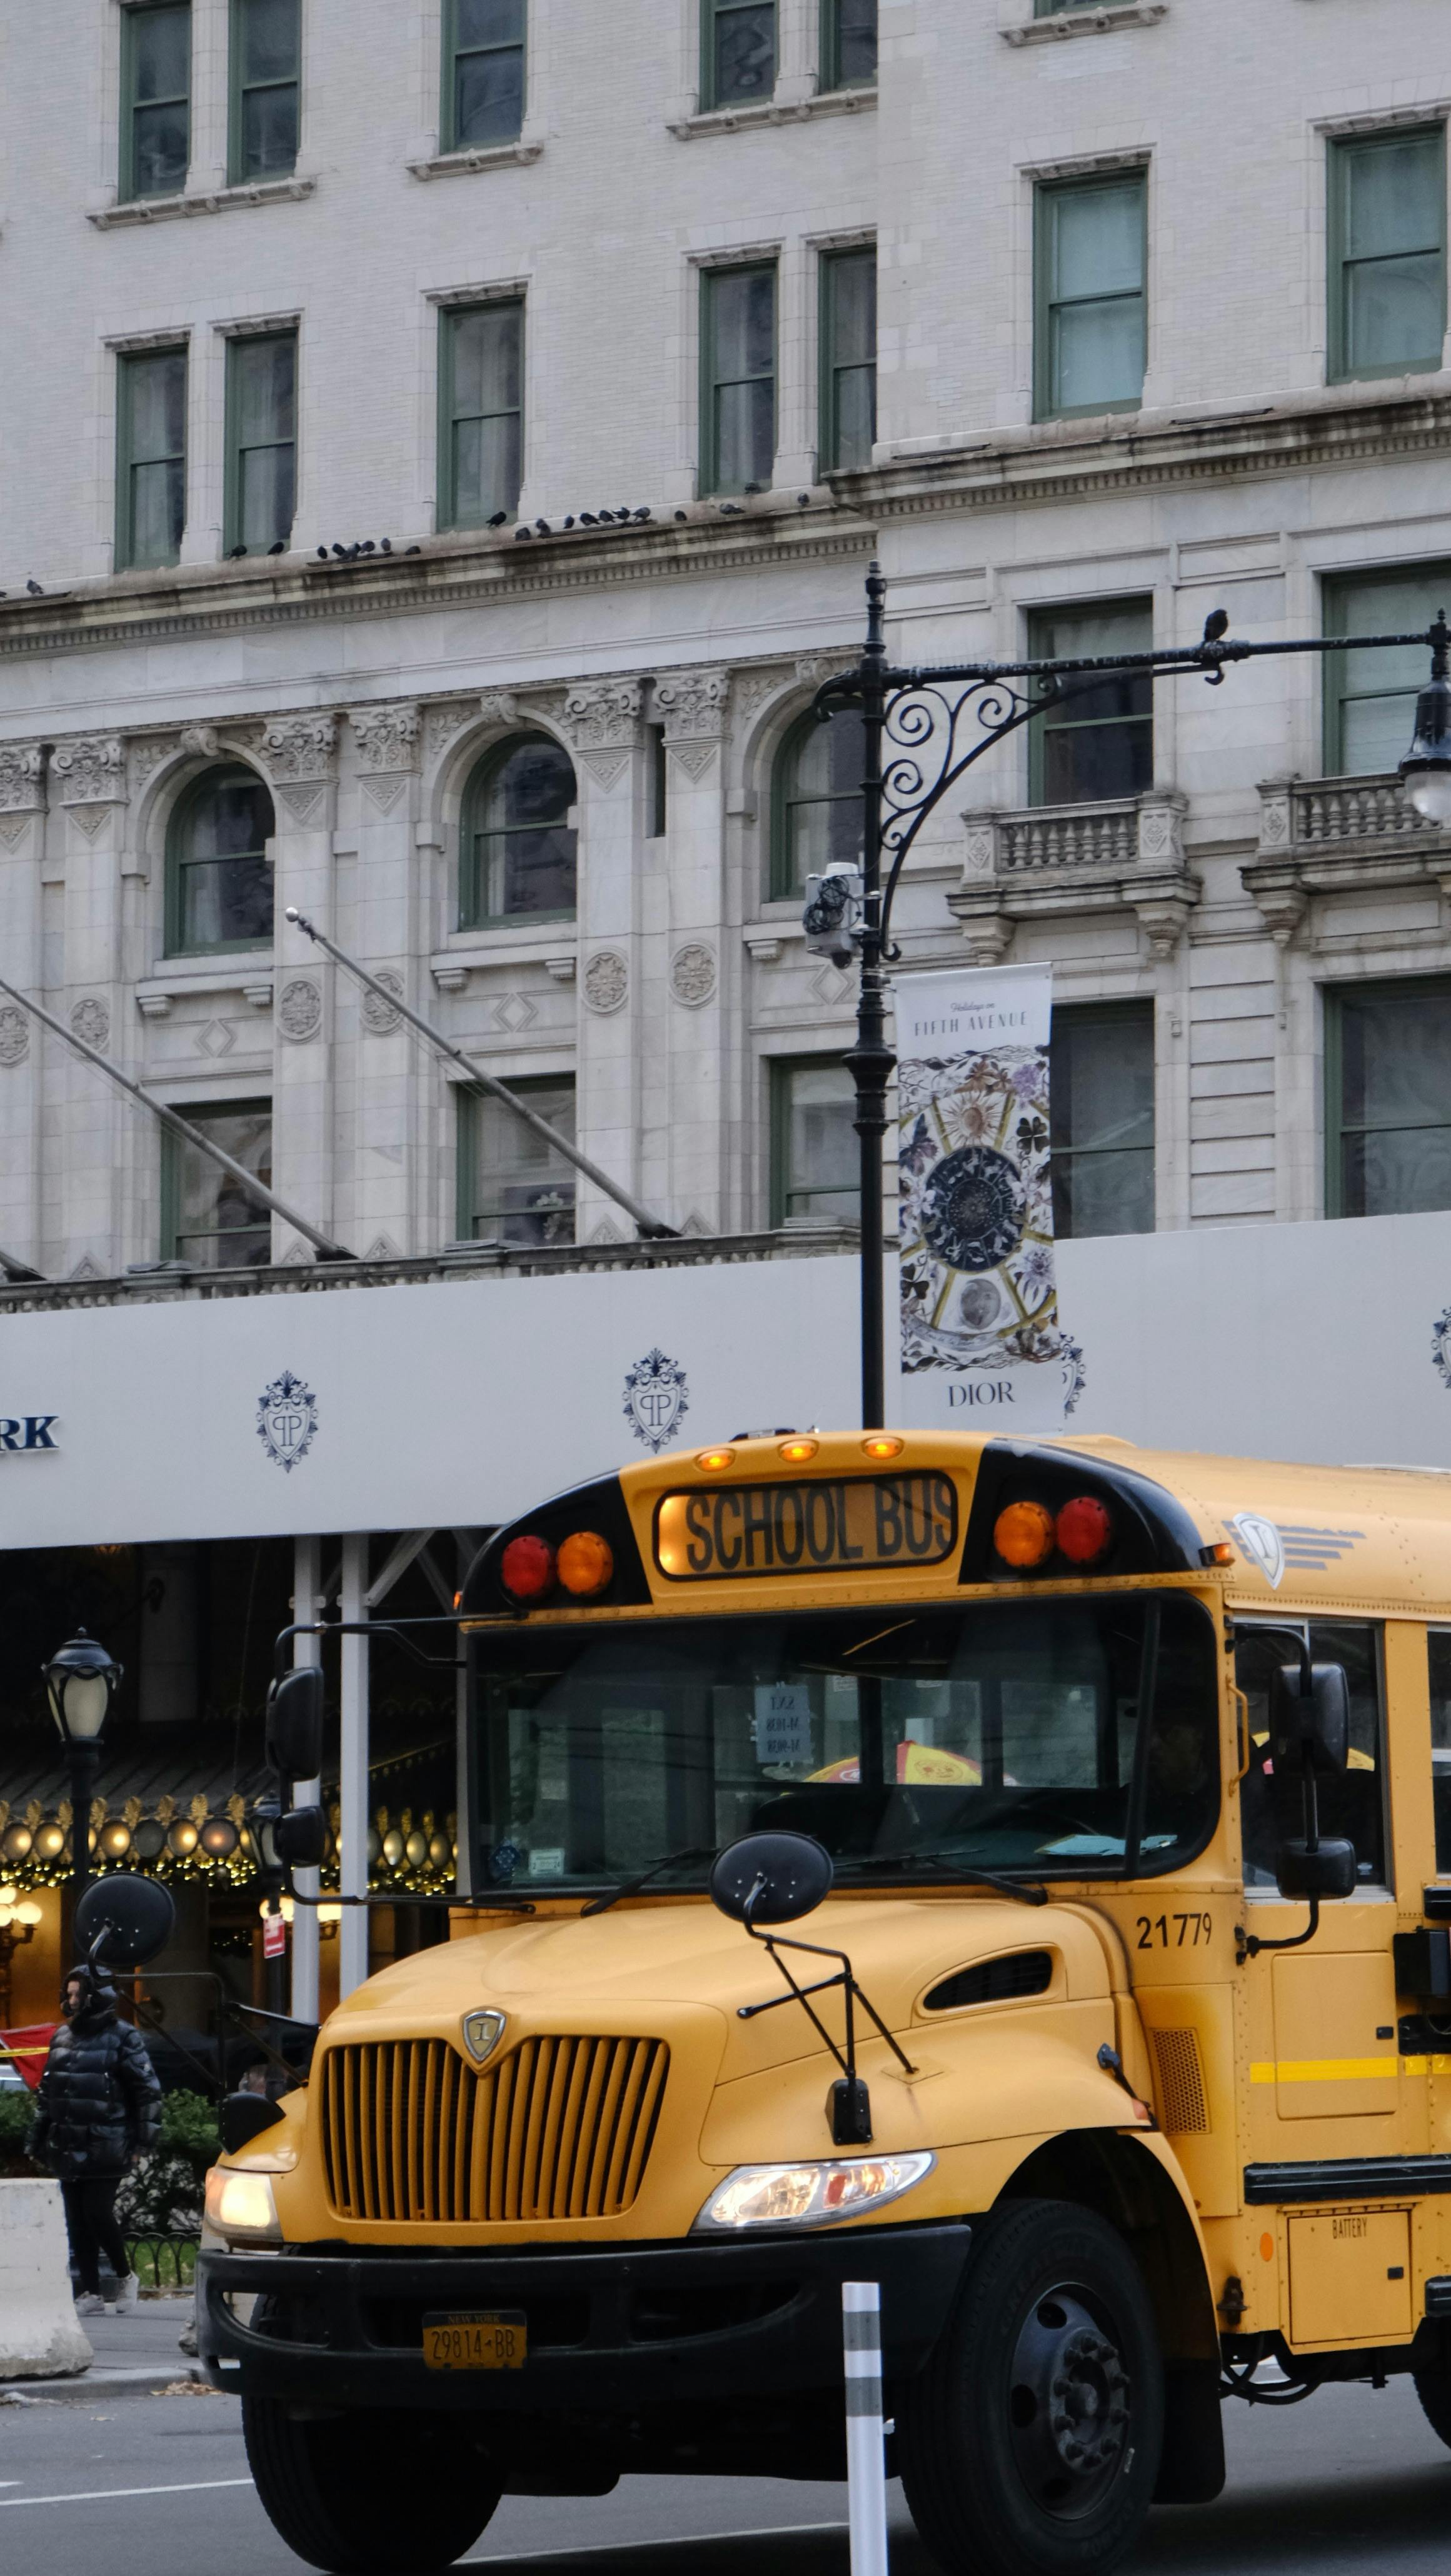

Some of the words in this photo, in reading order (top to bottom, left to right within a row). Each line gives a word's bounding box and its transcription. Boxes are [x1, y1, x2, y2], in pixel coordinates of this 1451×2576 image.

[915, 1018, 959, 1036] FIFTH
[968, 1011, 1027, 1031] AVENUE
[948, 1381, 1015, 1407] DIOR
[686, 1484, 863, 1572] SCHOOL
[876, 1477, 951, 1558] BUS
[1137, 1912, 1212, 1949] 21779
[1332, 2218, 1367, 2239] BATTERY
[448, 2314, 471, 2324] NEW
[474, 2313, 501, 2323] YORK
